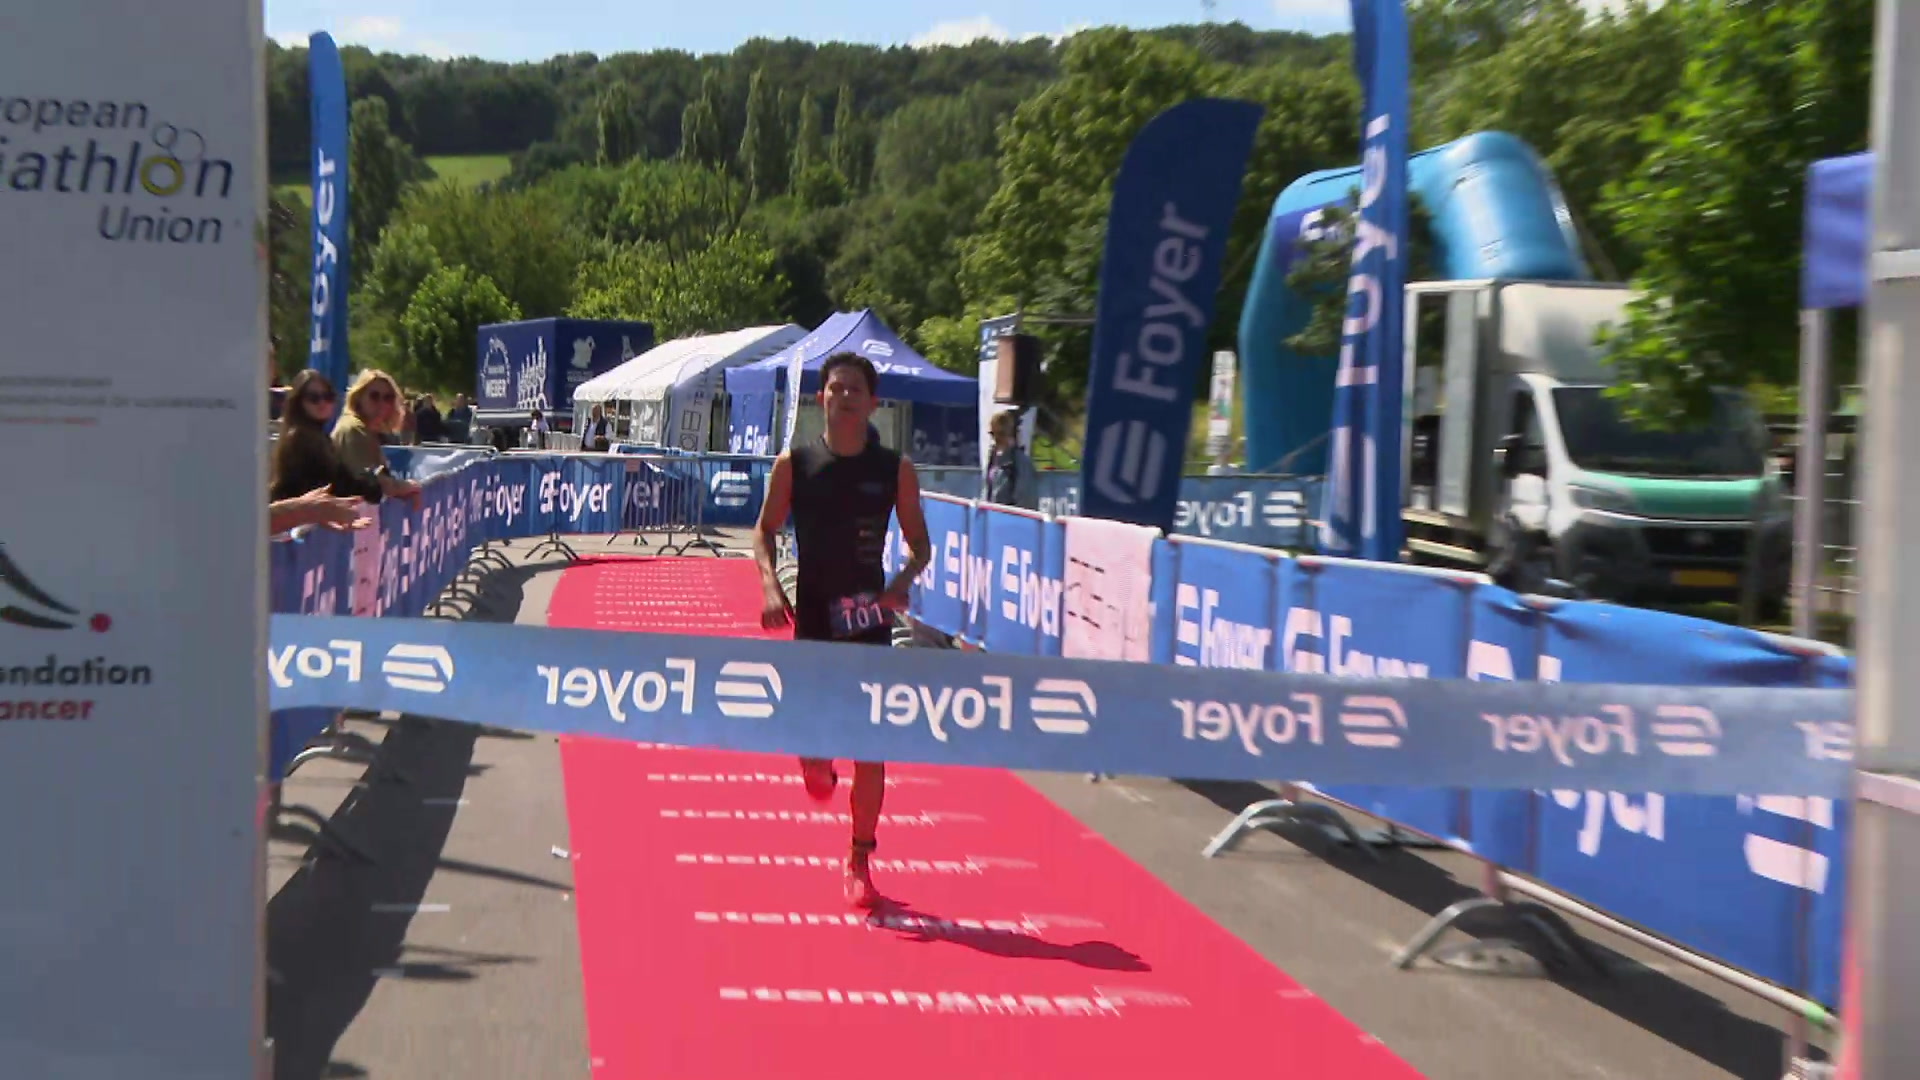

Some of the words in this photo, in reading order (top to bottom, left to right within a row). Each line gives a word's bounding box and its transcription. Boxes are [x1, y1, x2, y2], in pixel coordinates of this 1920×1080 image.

[0, 97, 148, 134] opean
[98, 204, 223, 244] Union
[1112, 200, 1213, 402] Foyer
[492, 473, 525, 526] oyer
[548, 471, 613, 522] Foyer
[842, 602, 884, 630] 101
[0, 655, 152, 686] ndation
